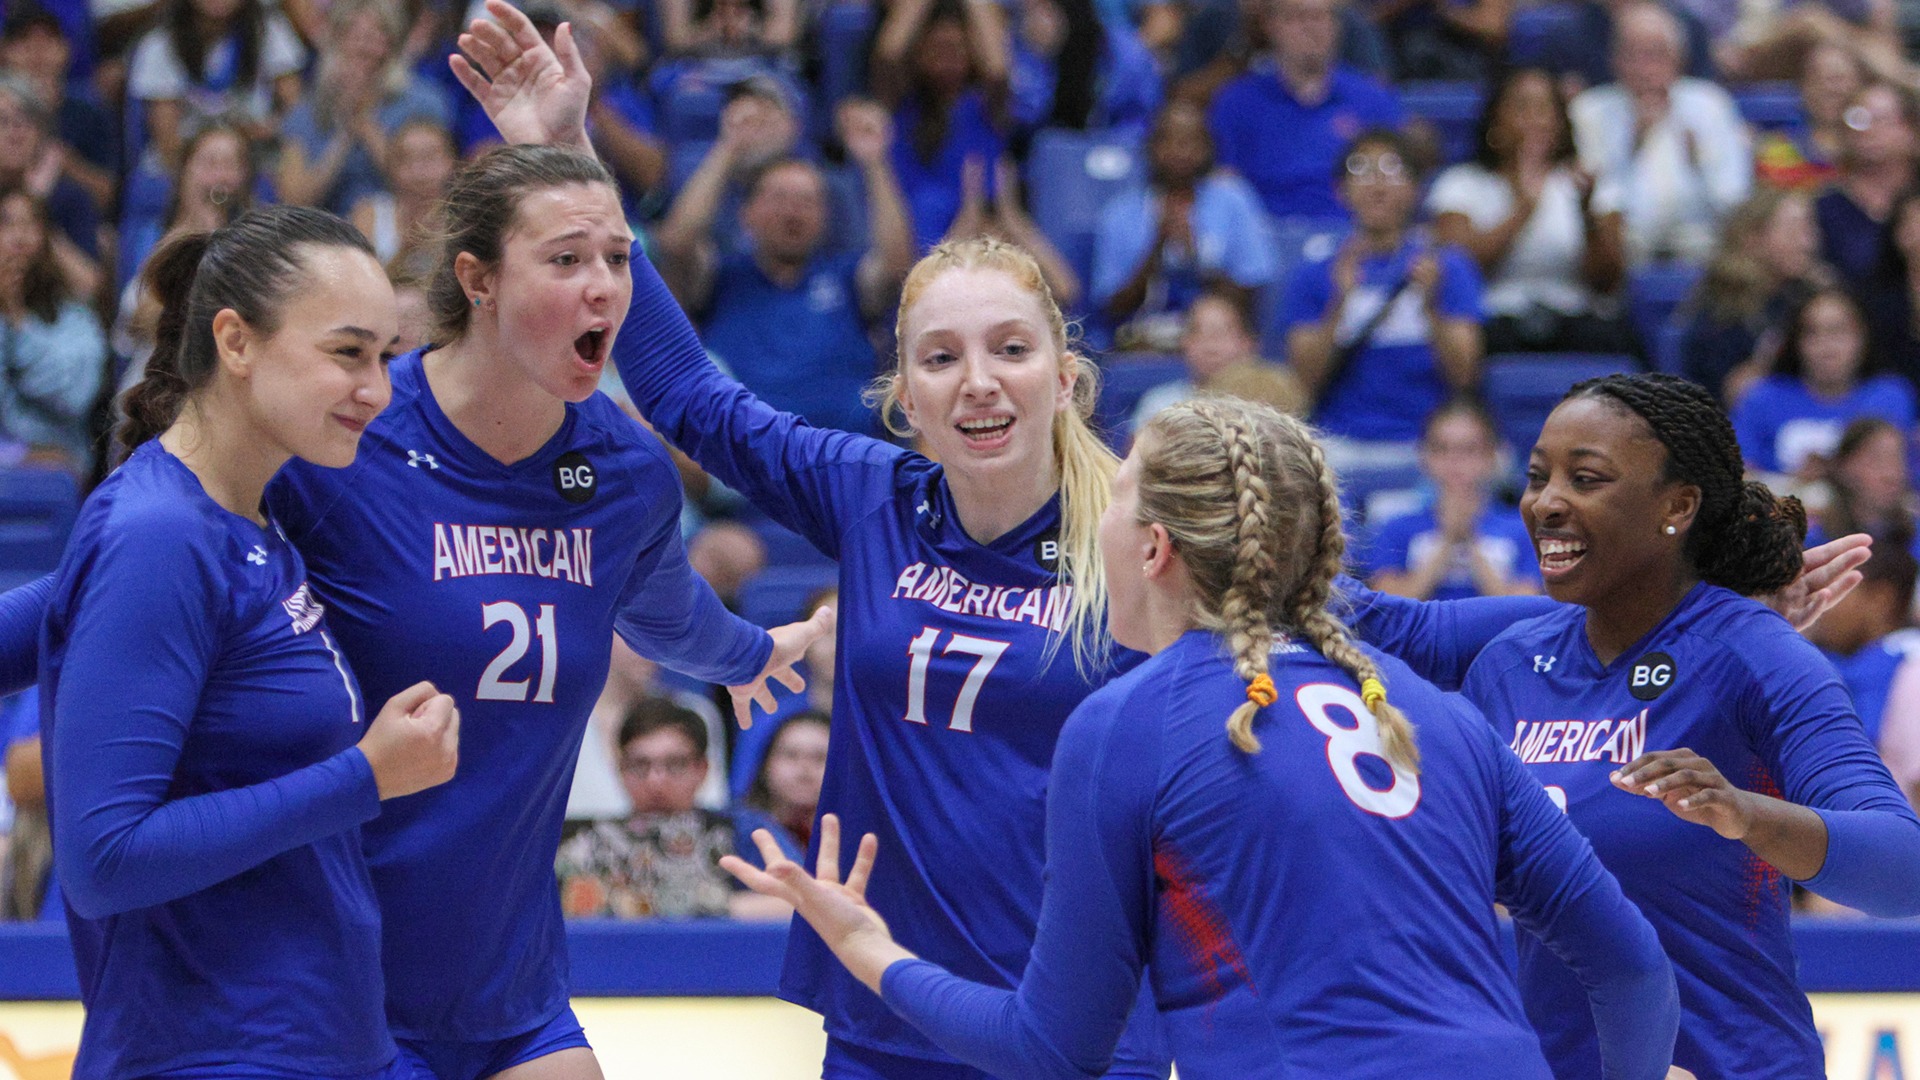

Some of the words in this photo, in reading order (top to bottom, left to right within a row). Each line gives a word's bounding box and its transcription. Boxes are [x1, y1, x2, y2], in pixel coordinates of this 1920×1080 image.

[559, 465, 593, 489] BG
[433, 522, 593, 588] AMERICAN
[891, 561, 1073, 633] AMERICAN
[475, 600, 558, 703] 21
[903, 626, 1011, 733] 17
[1632, 664, 1671, 687] BG
[1294, 682, 1422, 821] 8
[1510, 708, 1649, 764] AMERICAN
